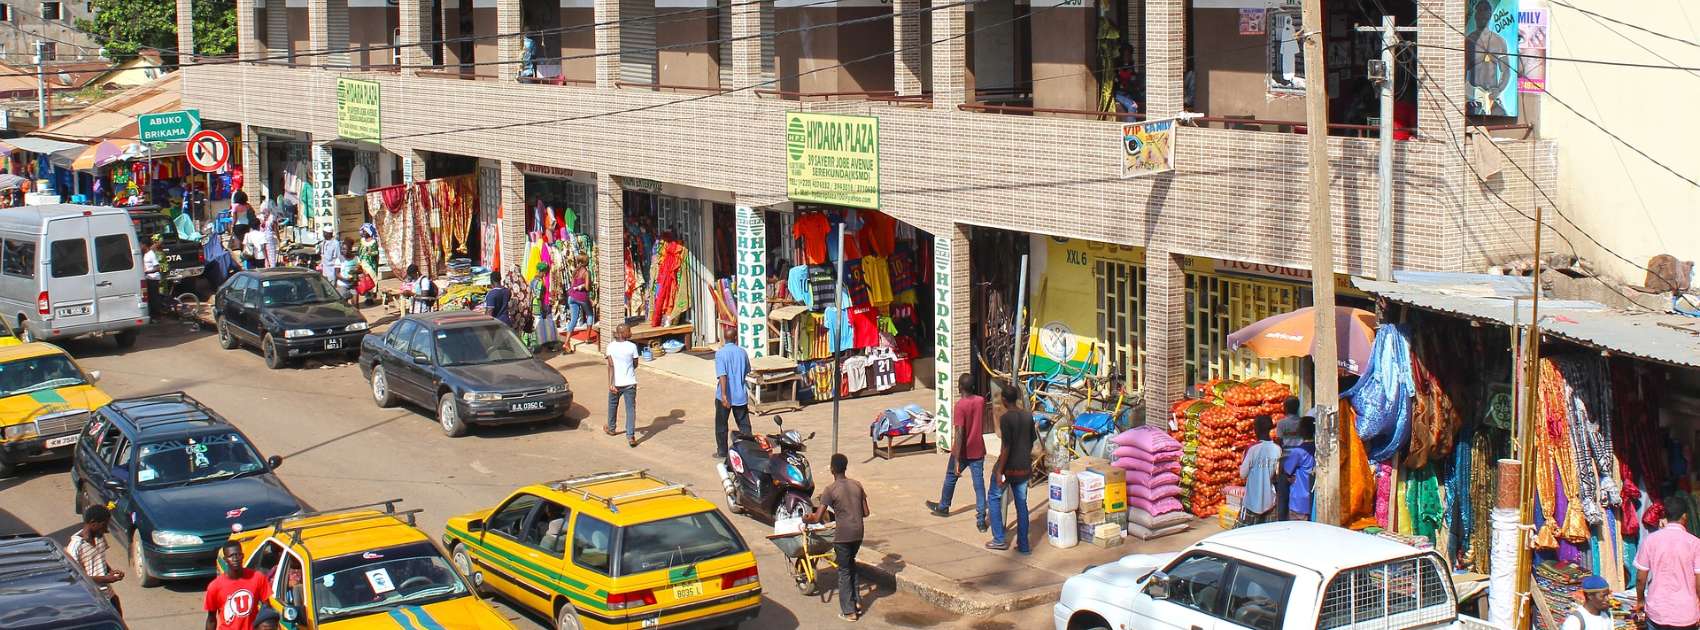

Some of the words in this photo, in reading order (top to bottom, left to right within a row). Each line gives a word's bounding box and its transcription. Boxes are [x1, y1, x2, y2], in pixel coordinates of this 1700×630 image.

[1494, 8, 1509, 22] DAL
[150, 116, 182, 125] ABUKO
[145, 128, 186, 139] BRIKAMA
[807, 121, 843, 151] HYDARA
[845, 122, 875, 153] PLAZA
[1123, 125, 1142, 136] VIP
[836, 157, 850, 169] JOBE
[851, 158, 874, 171] AVENUE
[320, 161, 333, 216] HYDARA
[1066, 248, 1080, 265] XXL
[1081, 252, 1088, 265] 6
[738, 237, 749, 317] HYDARA
[750, 237, 765, 318] HYDARA
[936, 272, 950, 363] HYDARA
[878, 359, 889, 373] 21
[937, 371, 950, 449] PLAZA
[235, 595, 249, 613] U
